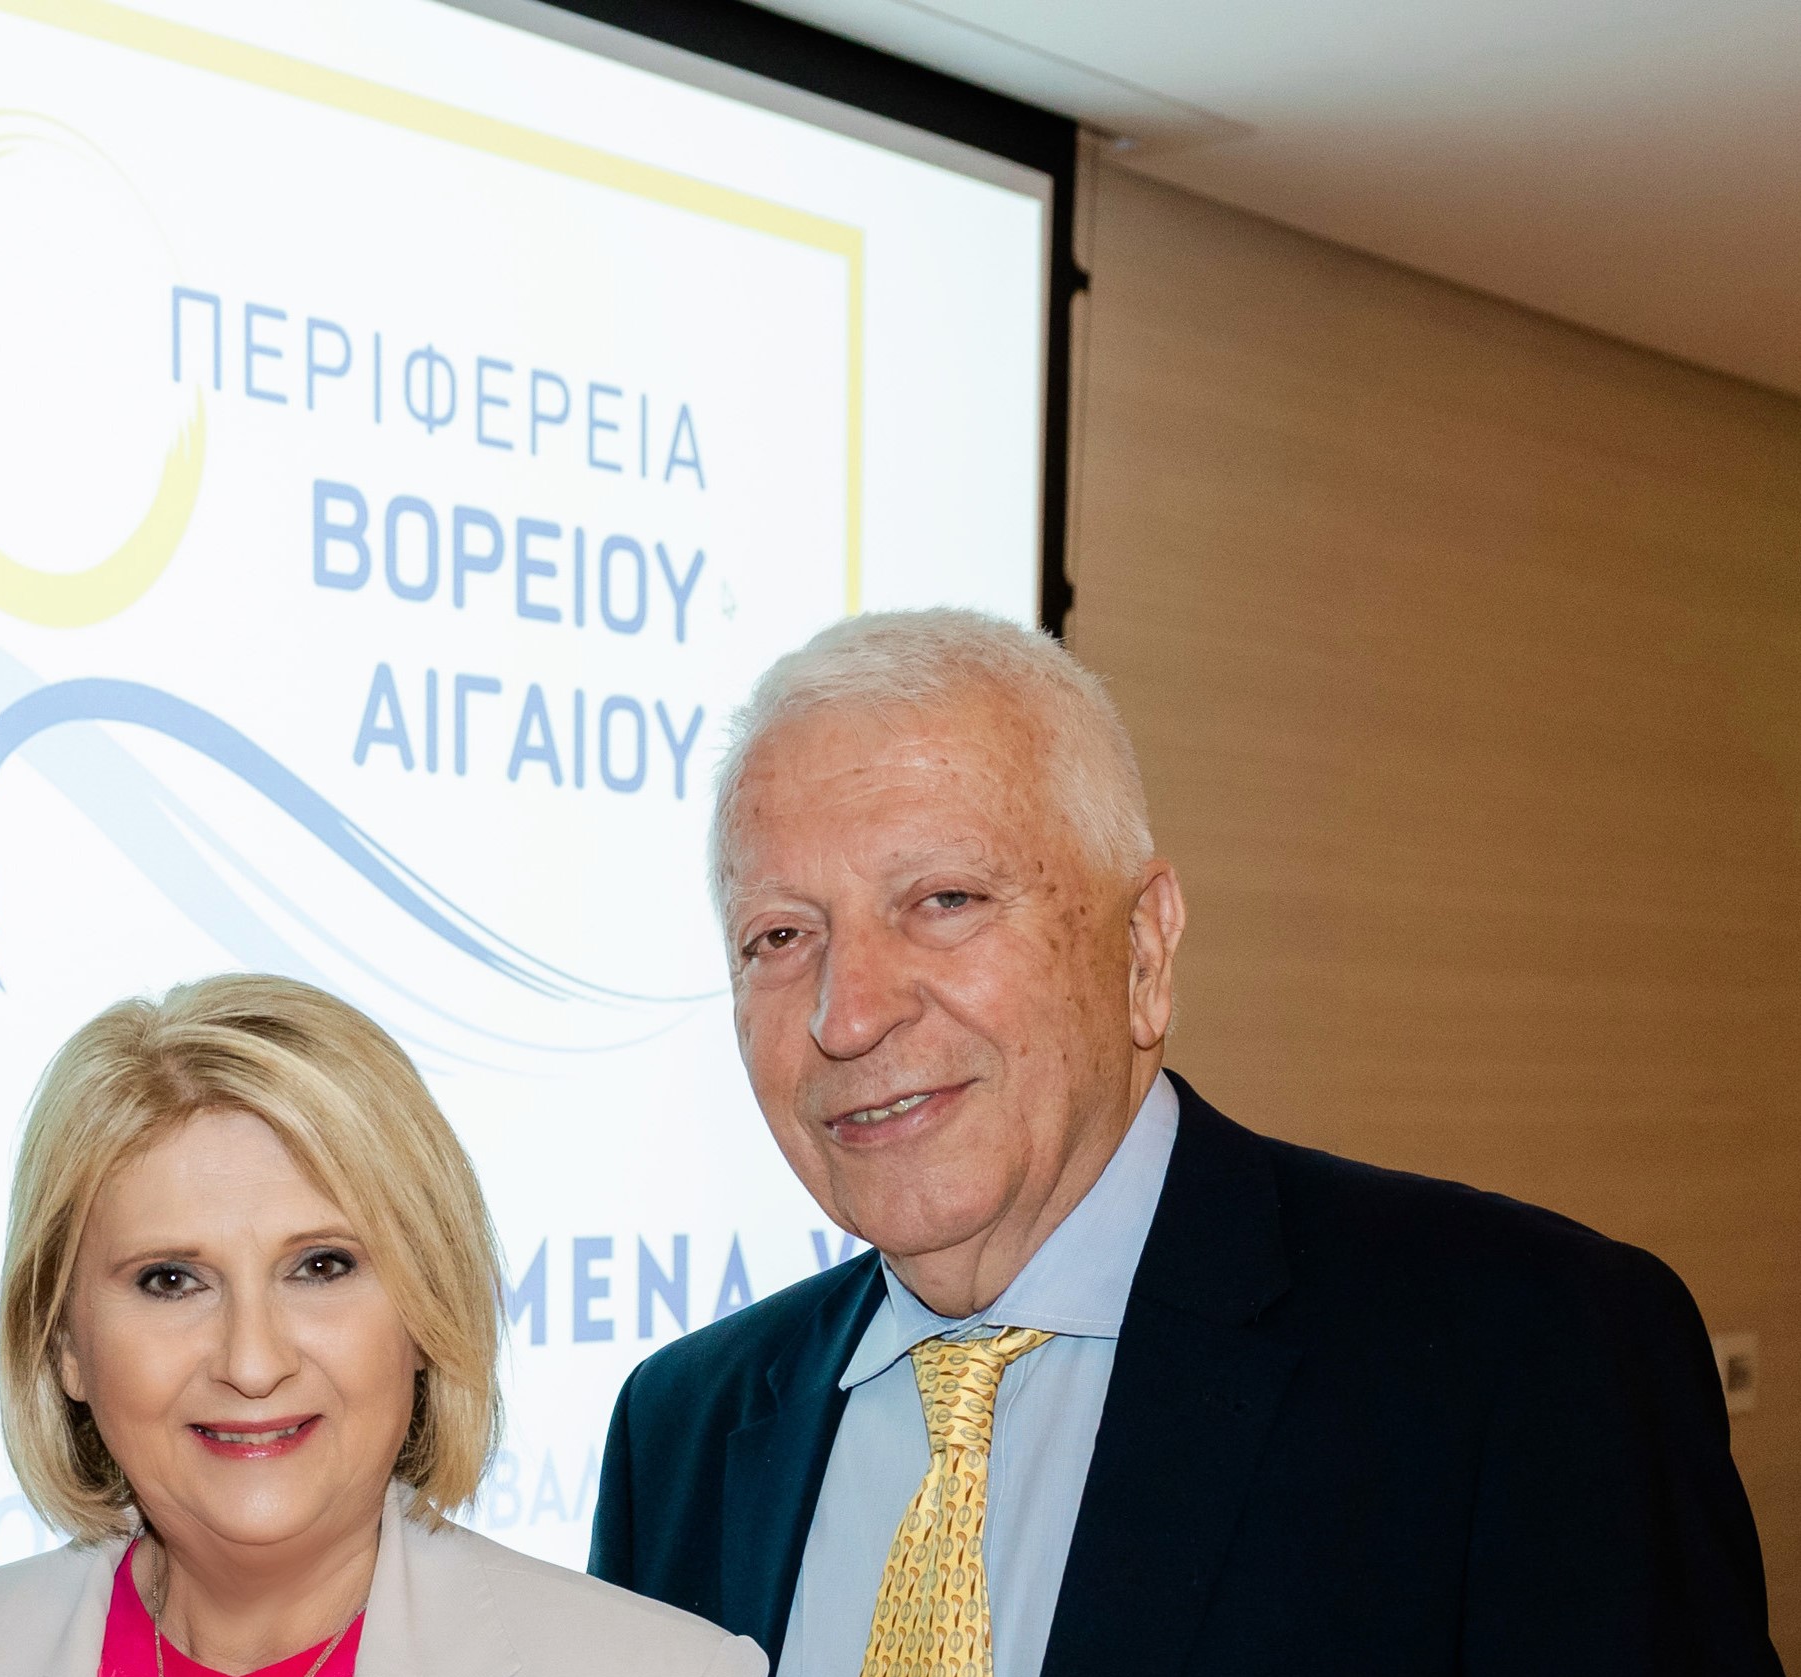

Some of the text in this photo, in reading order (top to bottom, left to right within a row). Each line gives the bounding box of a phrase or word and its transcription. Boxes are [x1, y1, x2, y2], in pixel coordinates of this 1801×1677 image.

[171, 284, 706, 491] ΠΕΡΙΦΕΡΕΙΑ
[312, 477, 706, 645] ΒΟΡΕΙΟΥ
[352, 661, 705, 801] ΑΙΓΑΙΟΥ
